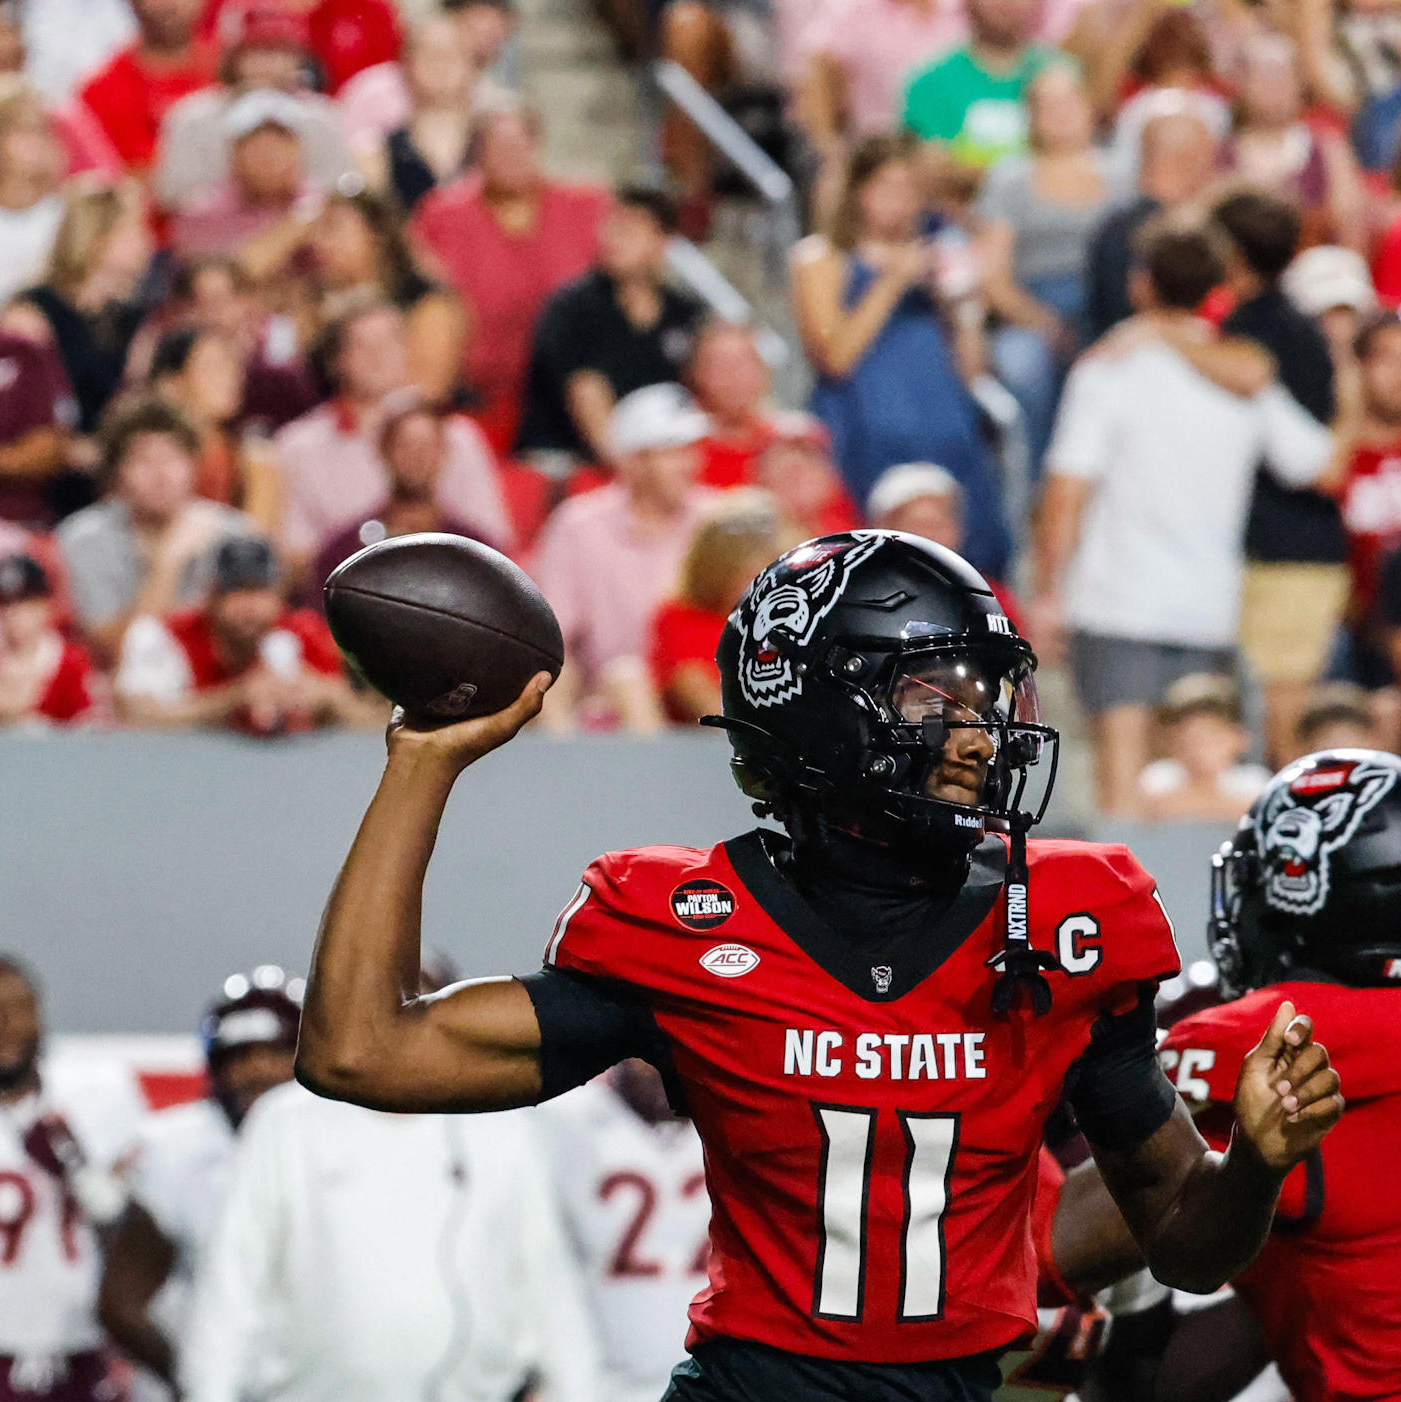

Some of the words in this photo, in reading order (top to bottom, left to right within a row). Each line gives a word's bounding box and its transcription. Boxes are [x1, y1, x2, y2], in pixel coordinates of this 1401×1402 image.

[675, 900, 732, 916] WILSON
[687, 893, 718, 904] PAYTON
[1008, 884, 1027, 940] NXTRND
[710, 953, 750, 964] ACC
[1056, 912, 1101, 976] C
[784, 1028, 843, 1078] NC
[855, 1032, 986, 1080] STATE
[811, 1103, 959, 1321] 11
